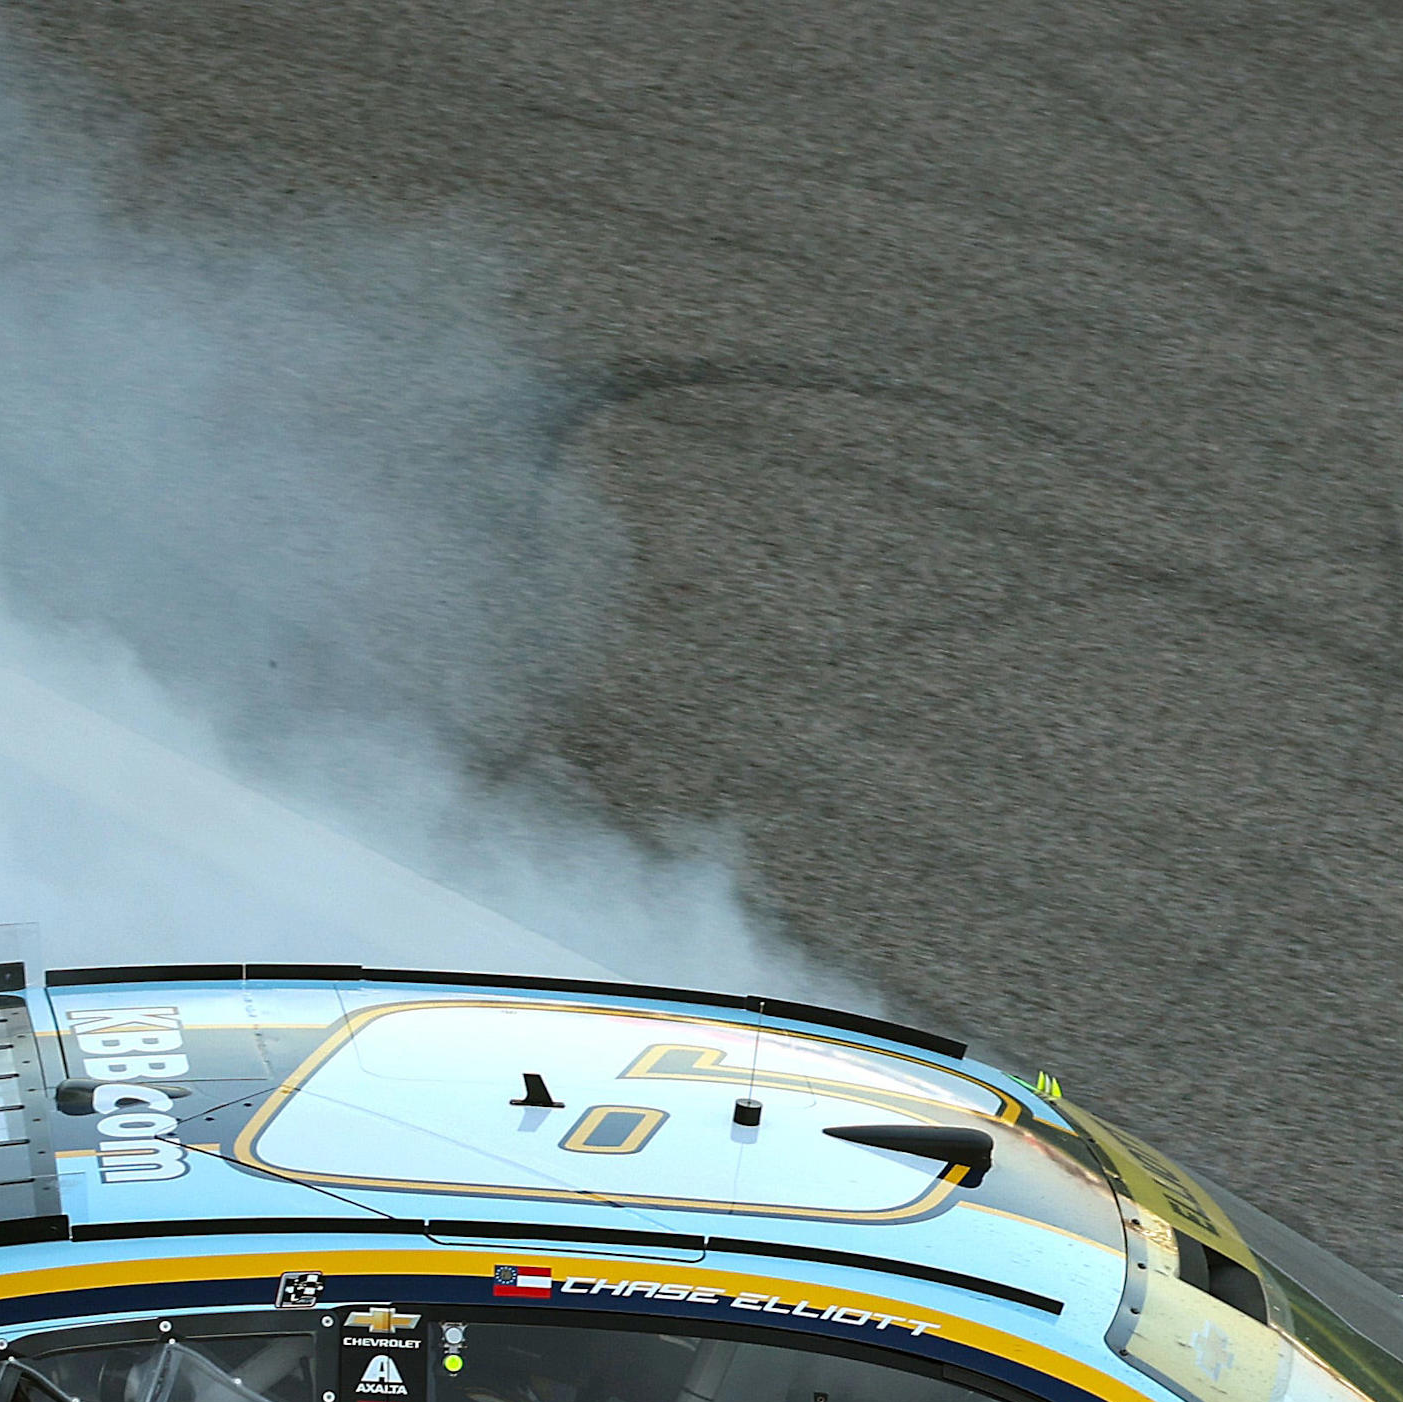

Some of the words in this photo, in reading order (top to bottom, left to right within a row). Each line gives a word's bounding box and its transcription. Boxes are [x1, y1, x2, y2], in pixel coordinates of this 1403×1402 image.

[560, 1276, 726, 1304] CHASE
[729, 1292, 942, 1337] ELLIOTT
[342, 1337, 421, 1349] CHEVROLET
[355, 1383, 408, 1395] AXALTA
